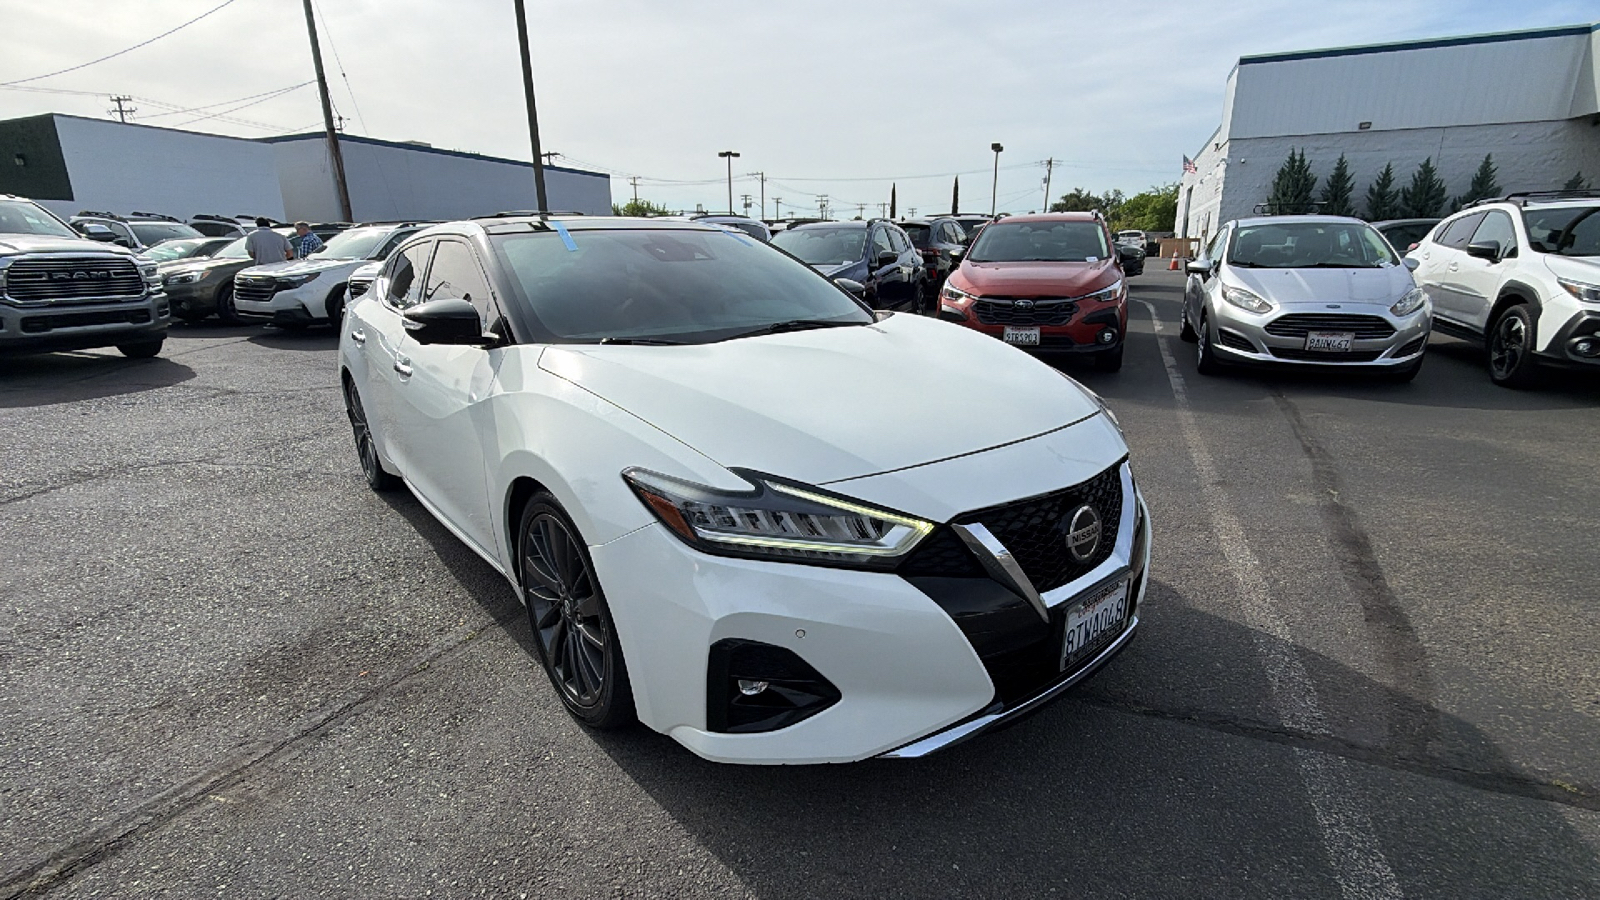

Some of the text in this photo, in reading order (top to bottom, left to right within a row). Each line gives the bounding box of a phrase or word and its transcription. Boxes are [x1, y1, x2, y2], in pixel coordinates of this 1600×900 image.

[51, 271, 108, 279] RAM
[1072, 525, 1099, 543] NISSAN
[1066, 597, 1124, 657] 8TWA048
